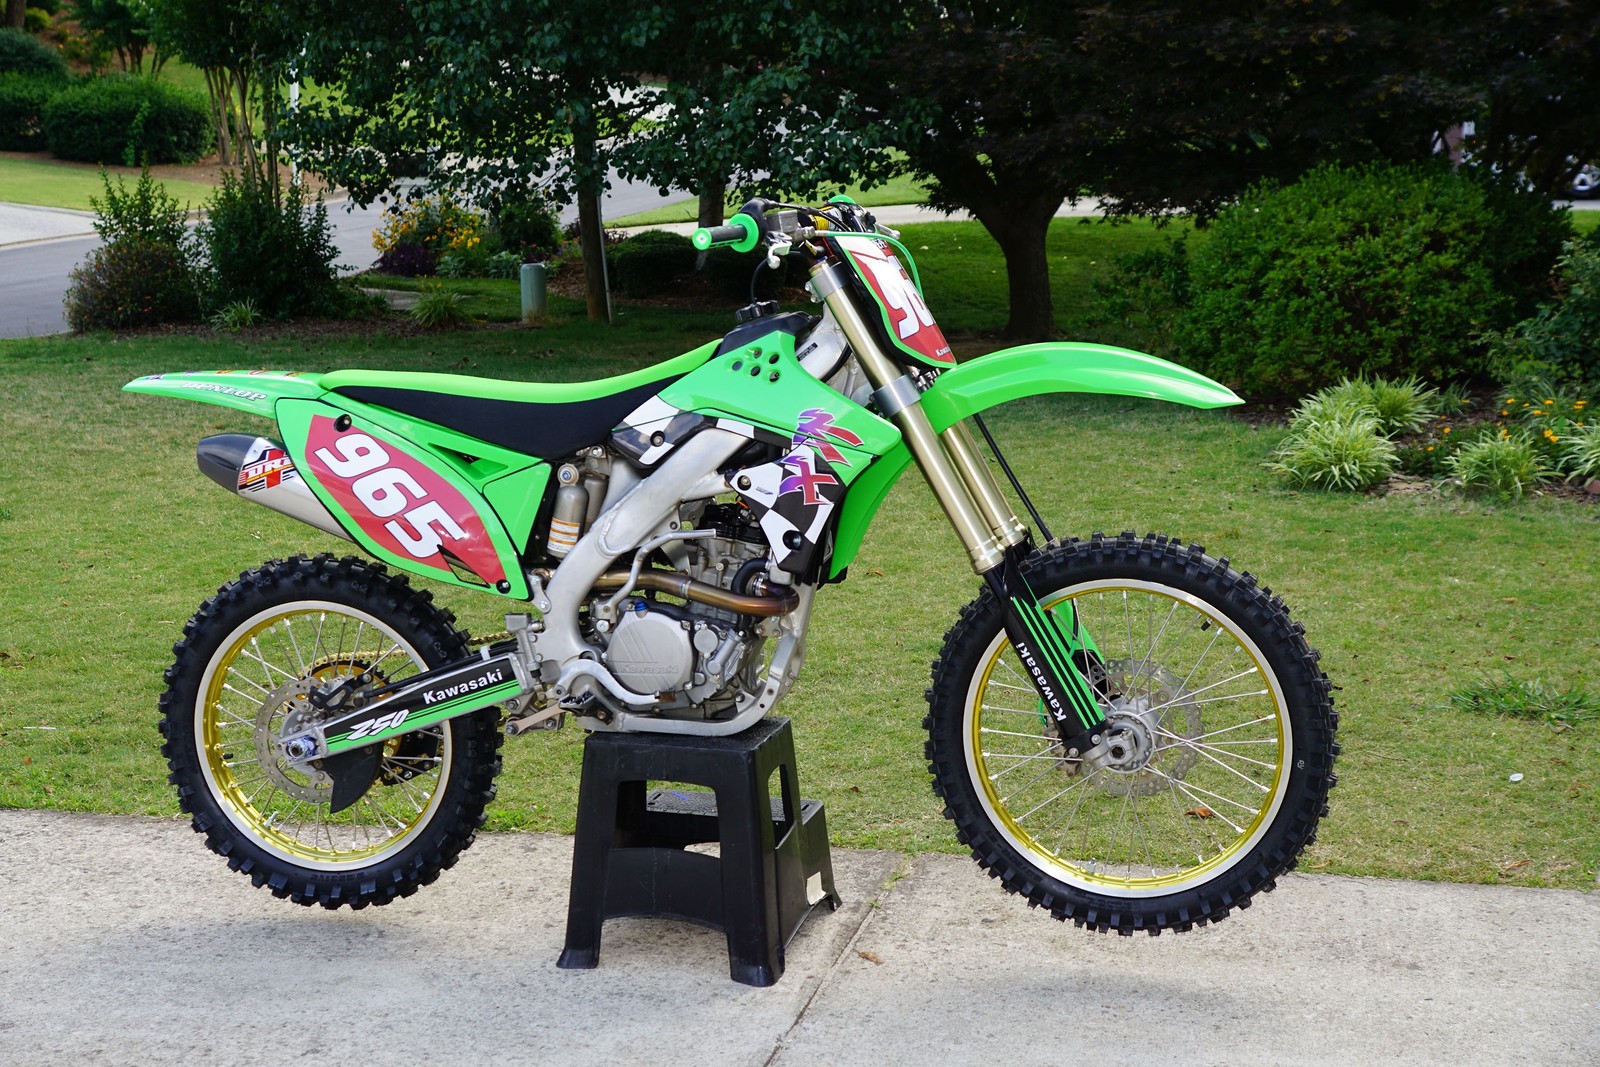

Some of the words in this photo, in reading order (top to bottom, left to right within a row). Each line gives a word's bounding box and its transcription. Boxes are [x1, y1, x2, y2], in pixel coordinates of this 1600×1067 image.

[181, 382, 268, 401] DUNLOP
[313, 433, 467, 559] 965
[422, 667, 504, 705] Kawasaki
[1015, 641, 1067, 723] Kawasaki
[346, 708, 410, 741] 250
